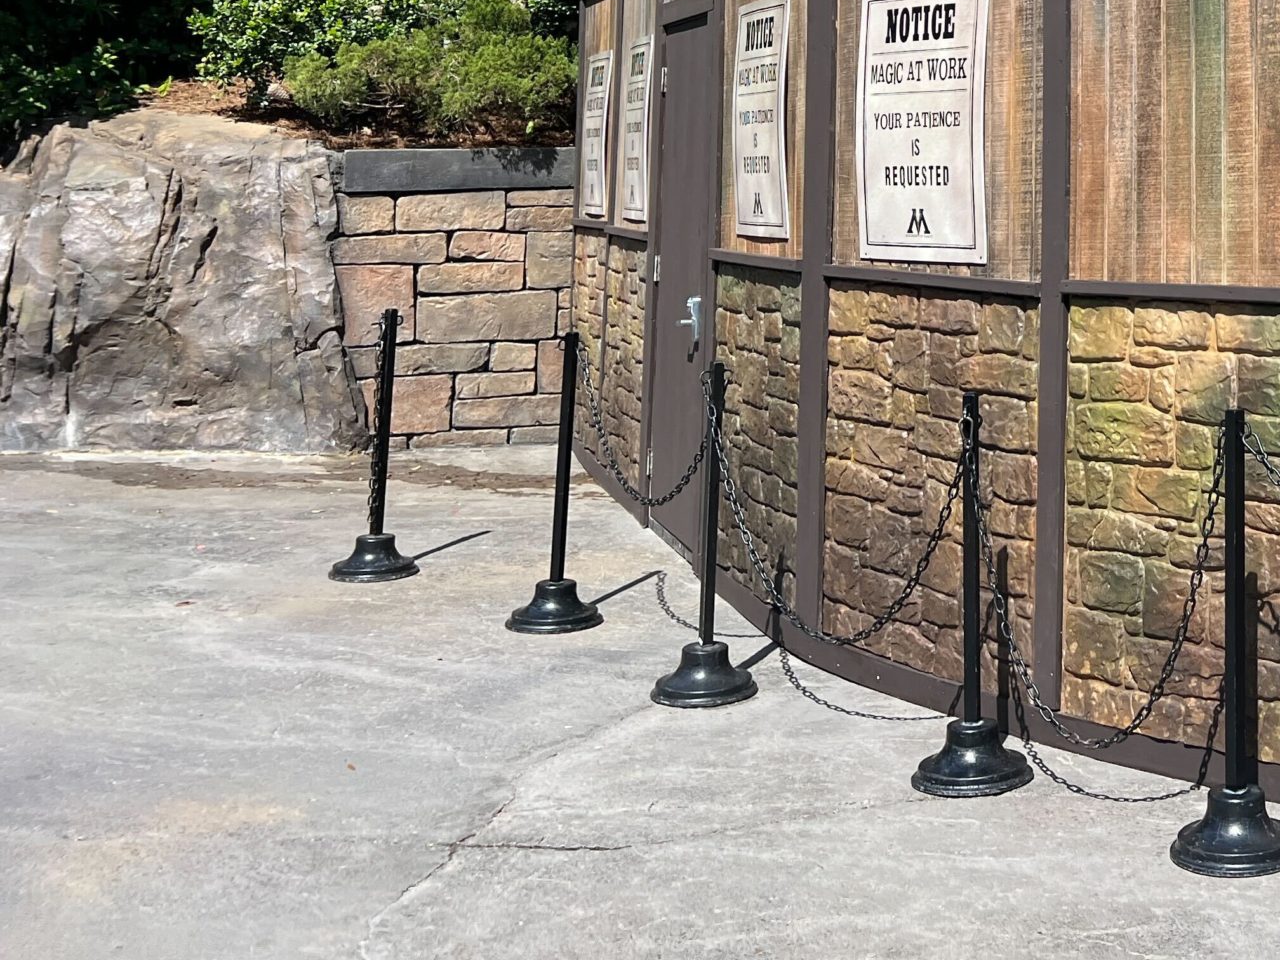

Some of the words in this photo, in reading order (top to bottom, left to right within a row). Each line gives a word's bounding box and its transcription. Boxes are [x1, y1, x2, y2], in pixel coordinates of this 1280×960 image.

[745, 16, 774, 52] NOTICE
[886, 3, 956, 43] NOTICE
[870, 62, 903, 85] MAGIC
[907, 61, 923, 81] AT
[927, 58, 968, 80] WORK
[874, 112, 902, 130] YOUR
[907, 111, 961, 128] PATIENCE
[912, 139, 920, 156] IS
[885, 165, 949, 188] REQUESTED
